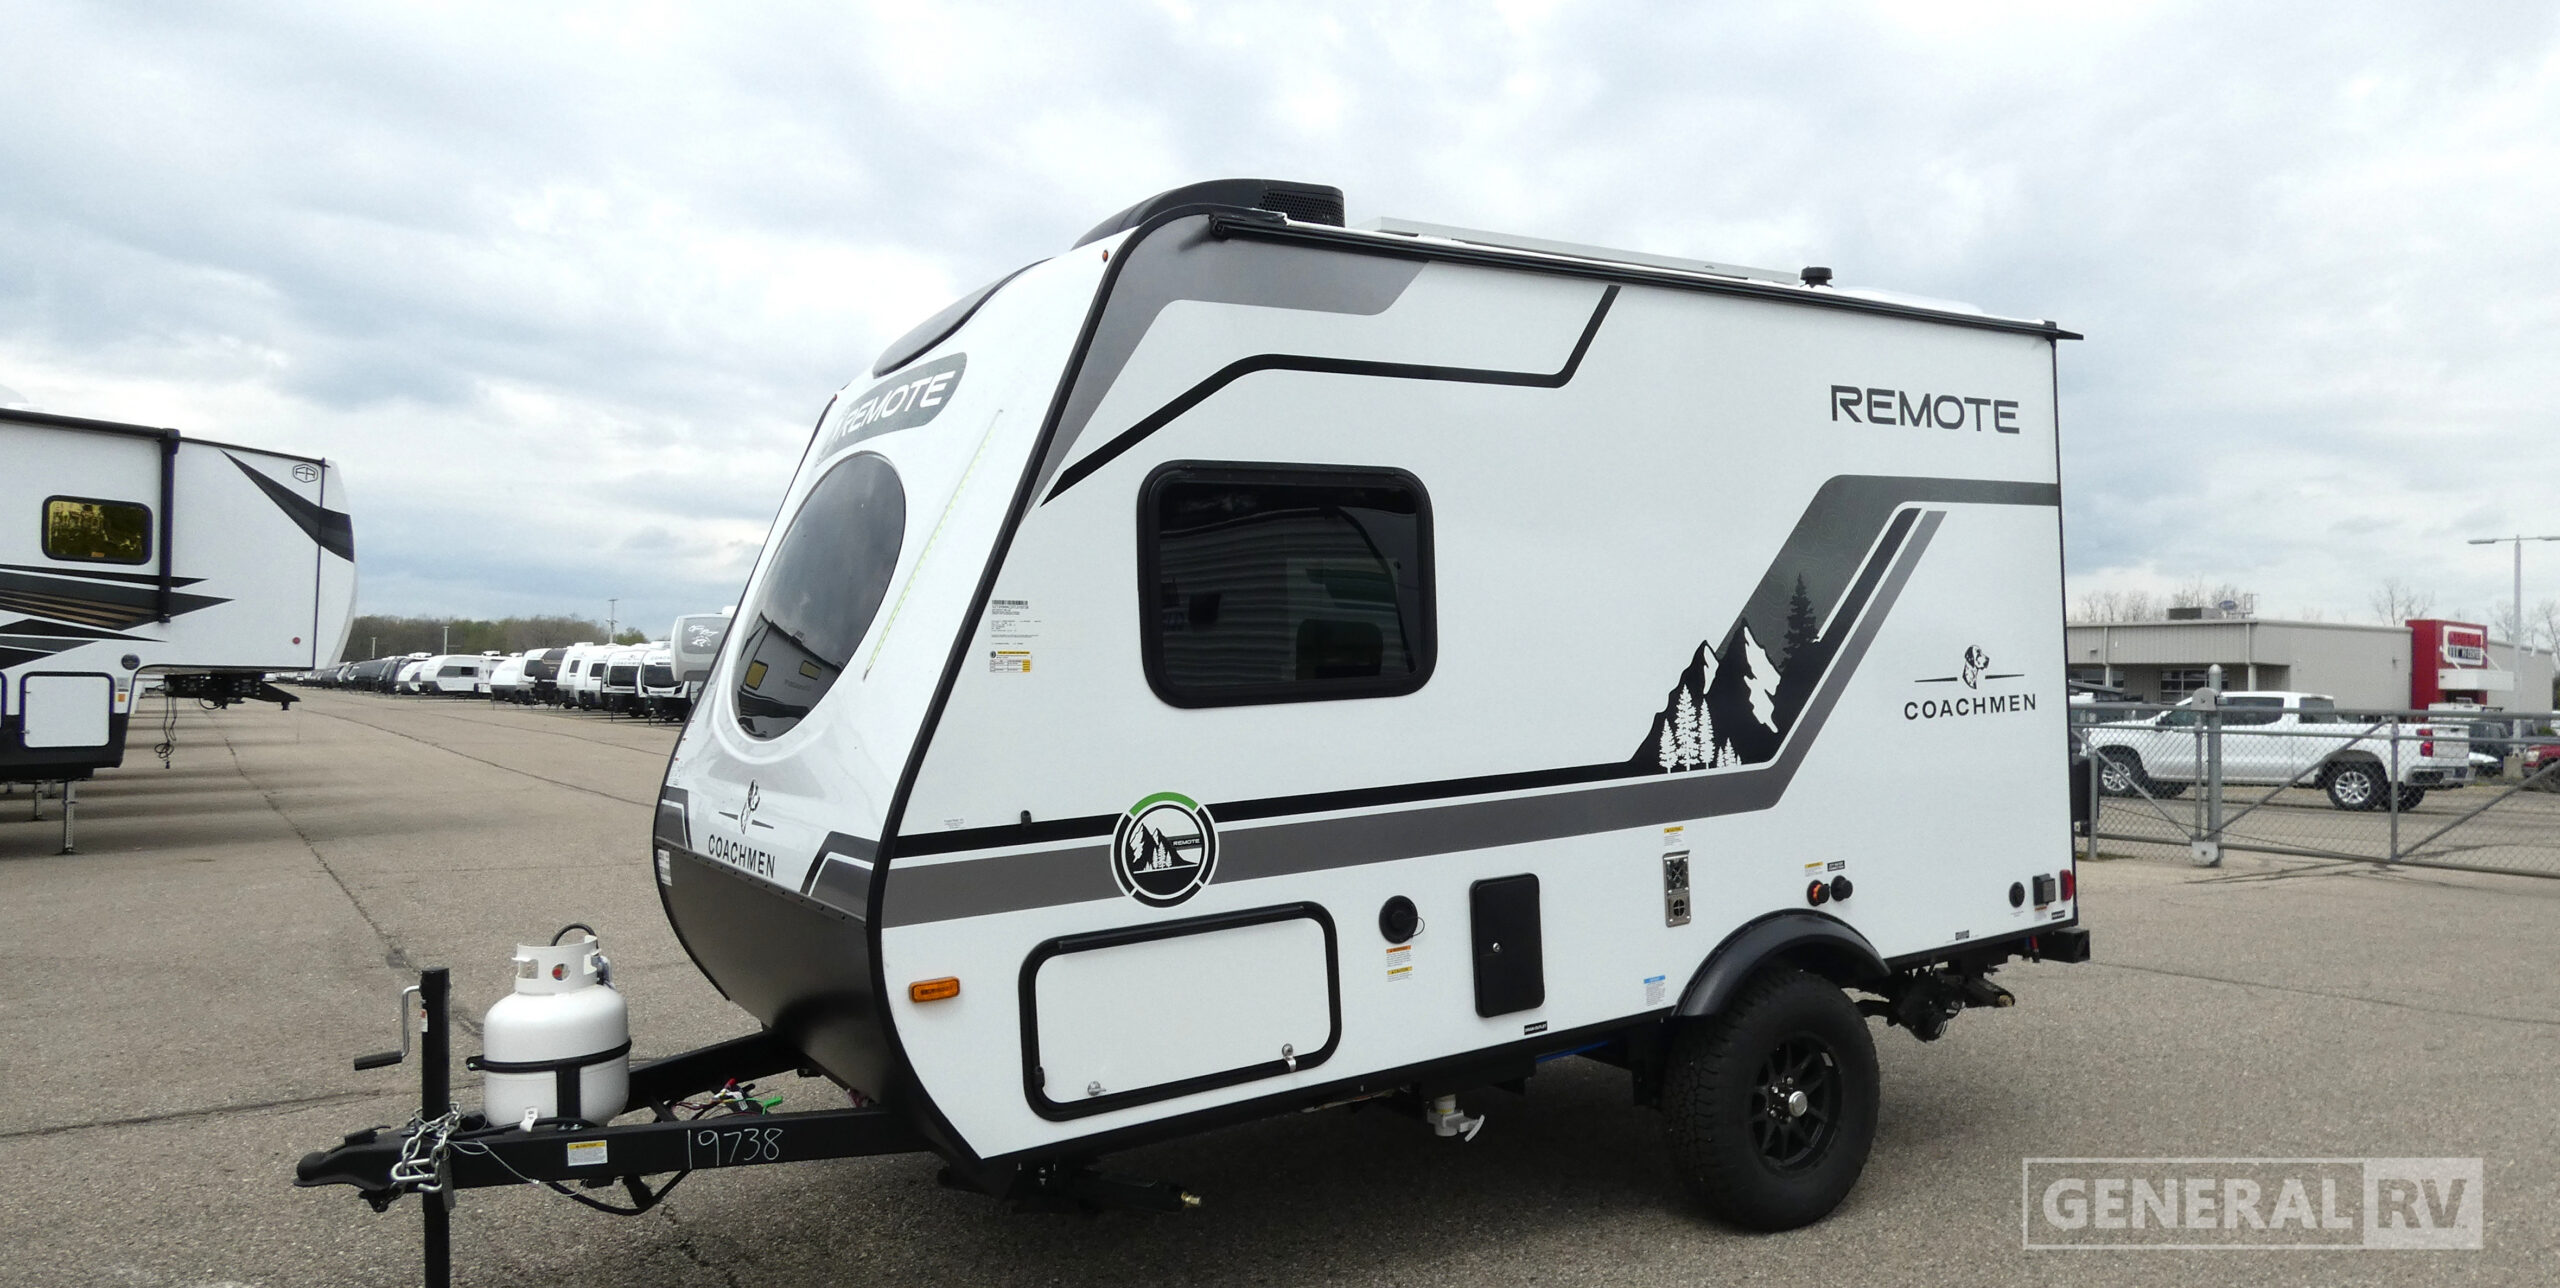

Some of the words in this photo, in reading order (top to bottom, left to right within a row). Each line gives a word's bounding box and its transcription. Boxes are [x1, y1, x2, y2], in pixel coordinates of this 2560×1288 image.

[832, 370, 956, 441] REMOTE
[1830, 384, 2020, 434] REMOTE
[1903, 693, 2037, 721] COACHMEN
[708, 833, 776, 879] COACHMEN
[1172, 838, 1200, 846] REMOTE
[687, 1127, 784, 1169] 19738
